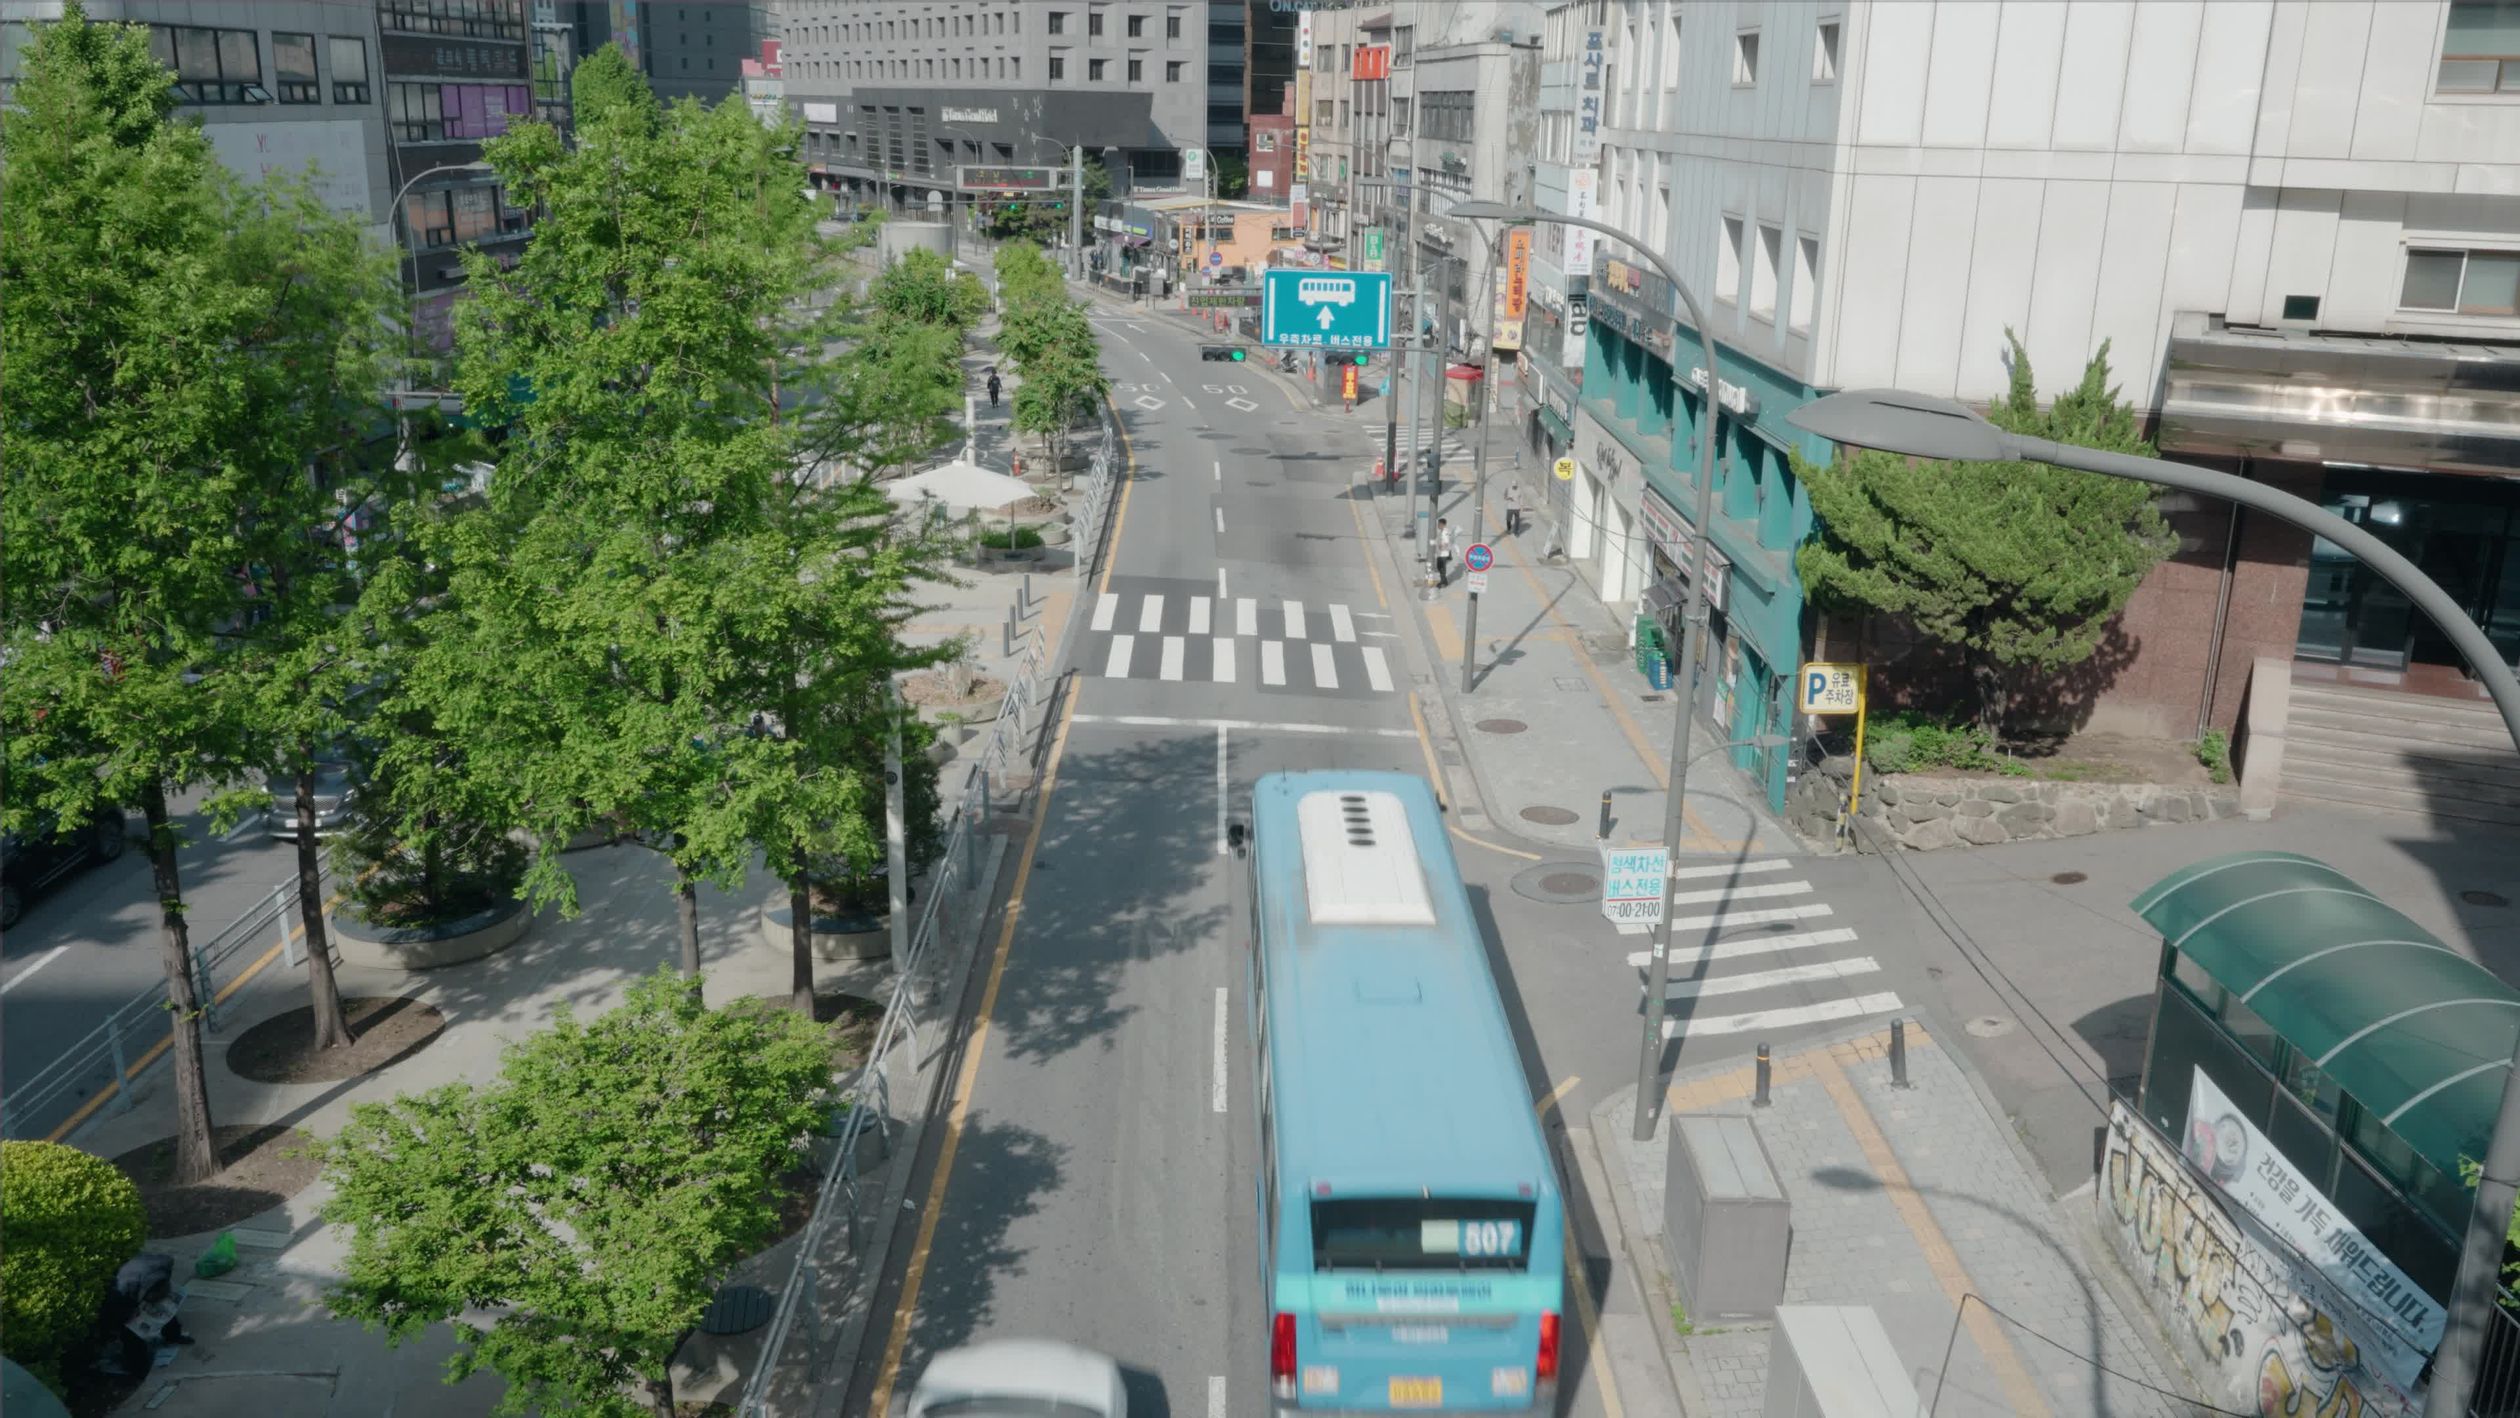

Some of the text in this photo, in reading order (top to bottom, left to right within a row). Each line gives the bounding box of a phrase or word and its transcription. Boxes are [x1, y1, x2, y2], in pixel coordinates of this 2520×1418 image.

[1580, 97, 1599, 137] 치과
[1280, 333, 1373, 347] 우측차로 버스전용
[1201, 384, 1249, 395] 50
[1808, 672, 1826, 705] P
[1832, 672, 1850, 688] 유료
[1824, 688, 1853, 705] 주차장
[1611, 855, 1665, 875] 청색차선
[1607, 879, 1660, 897] 버스전용
[2257, 1152, 2300, 1205] 건강을
[2295, 1194, 2331, 1236] 가득
[2324, 1227, 2430, 1334] 채워드립니다.
